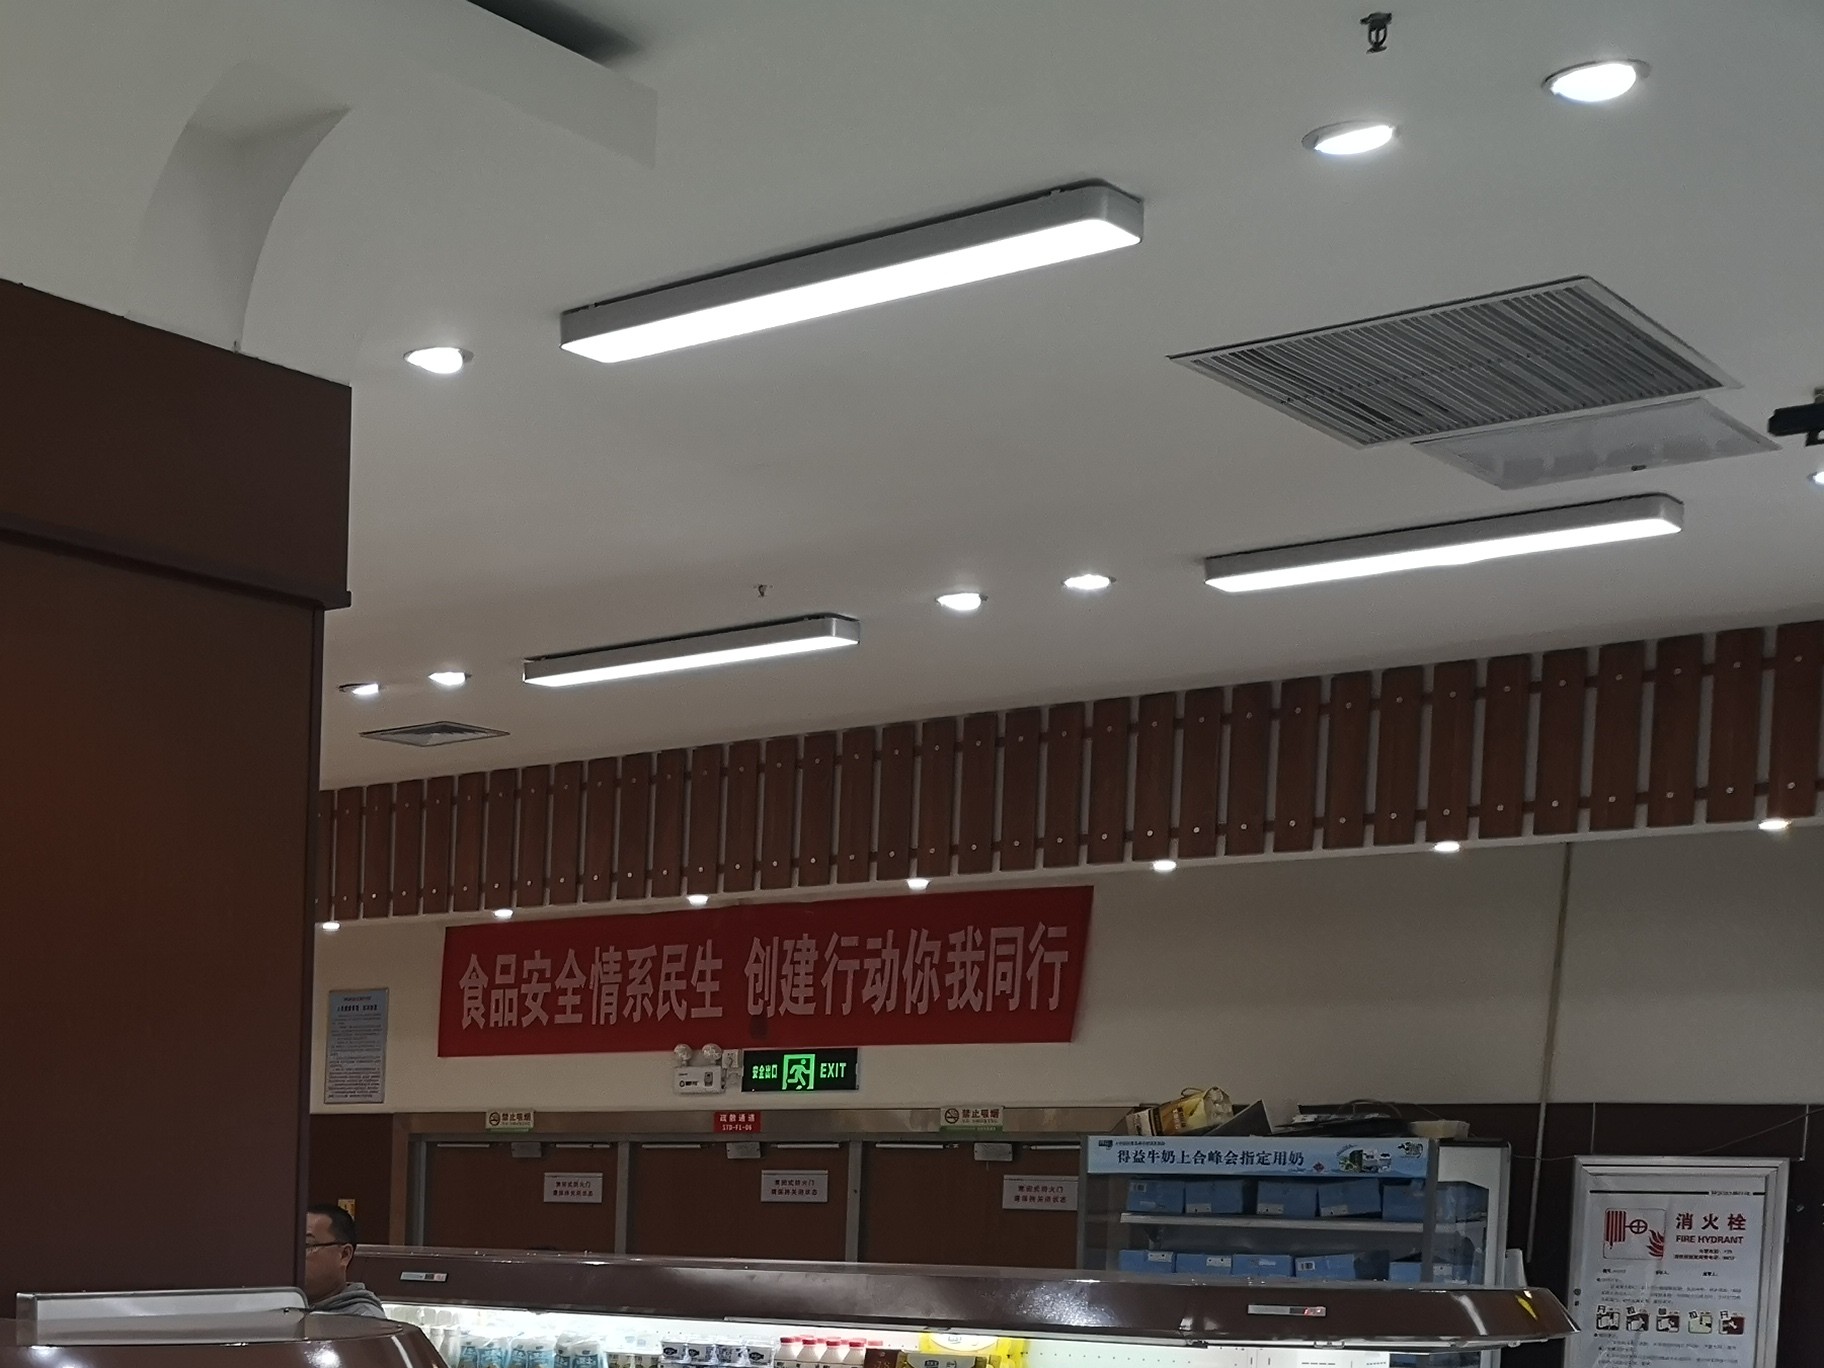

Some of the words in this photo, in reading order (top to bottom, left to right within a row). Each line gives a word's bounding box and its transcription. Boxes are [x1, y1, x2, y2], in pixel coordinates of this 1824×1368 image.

[459, 939, 723, 1030] 食品安全情系民生
[744, 922, 1068, 1017] 创建行动你我同行
[752, 1064, 777, 1079] 安全出口
[820, 1062, 847, 1079] EXIT
[962, 1109, 1000, 1118] 禁止吸烟
[1117, 1150, 1304, 1167] 得益牛奶上合峰会指定用奶
[1676, 1213, 1747, 1231] 消火栓
[1676, 1235, 1695, 1243] FIRE
[1698, 1235, 1744, 1244] HYDRANT
